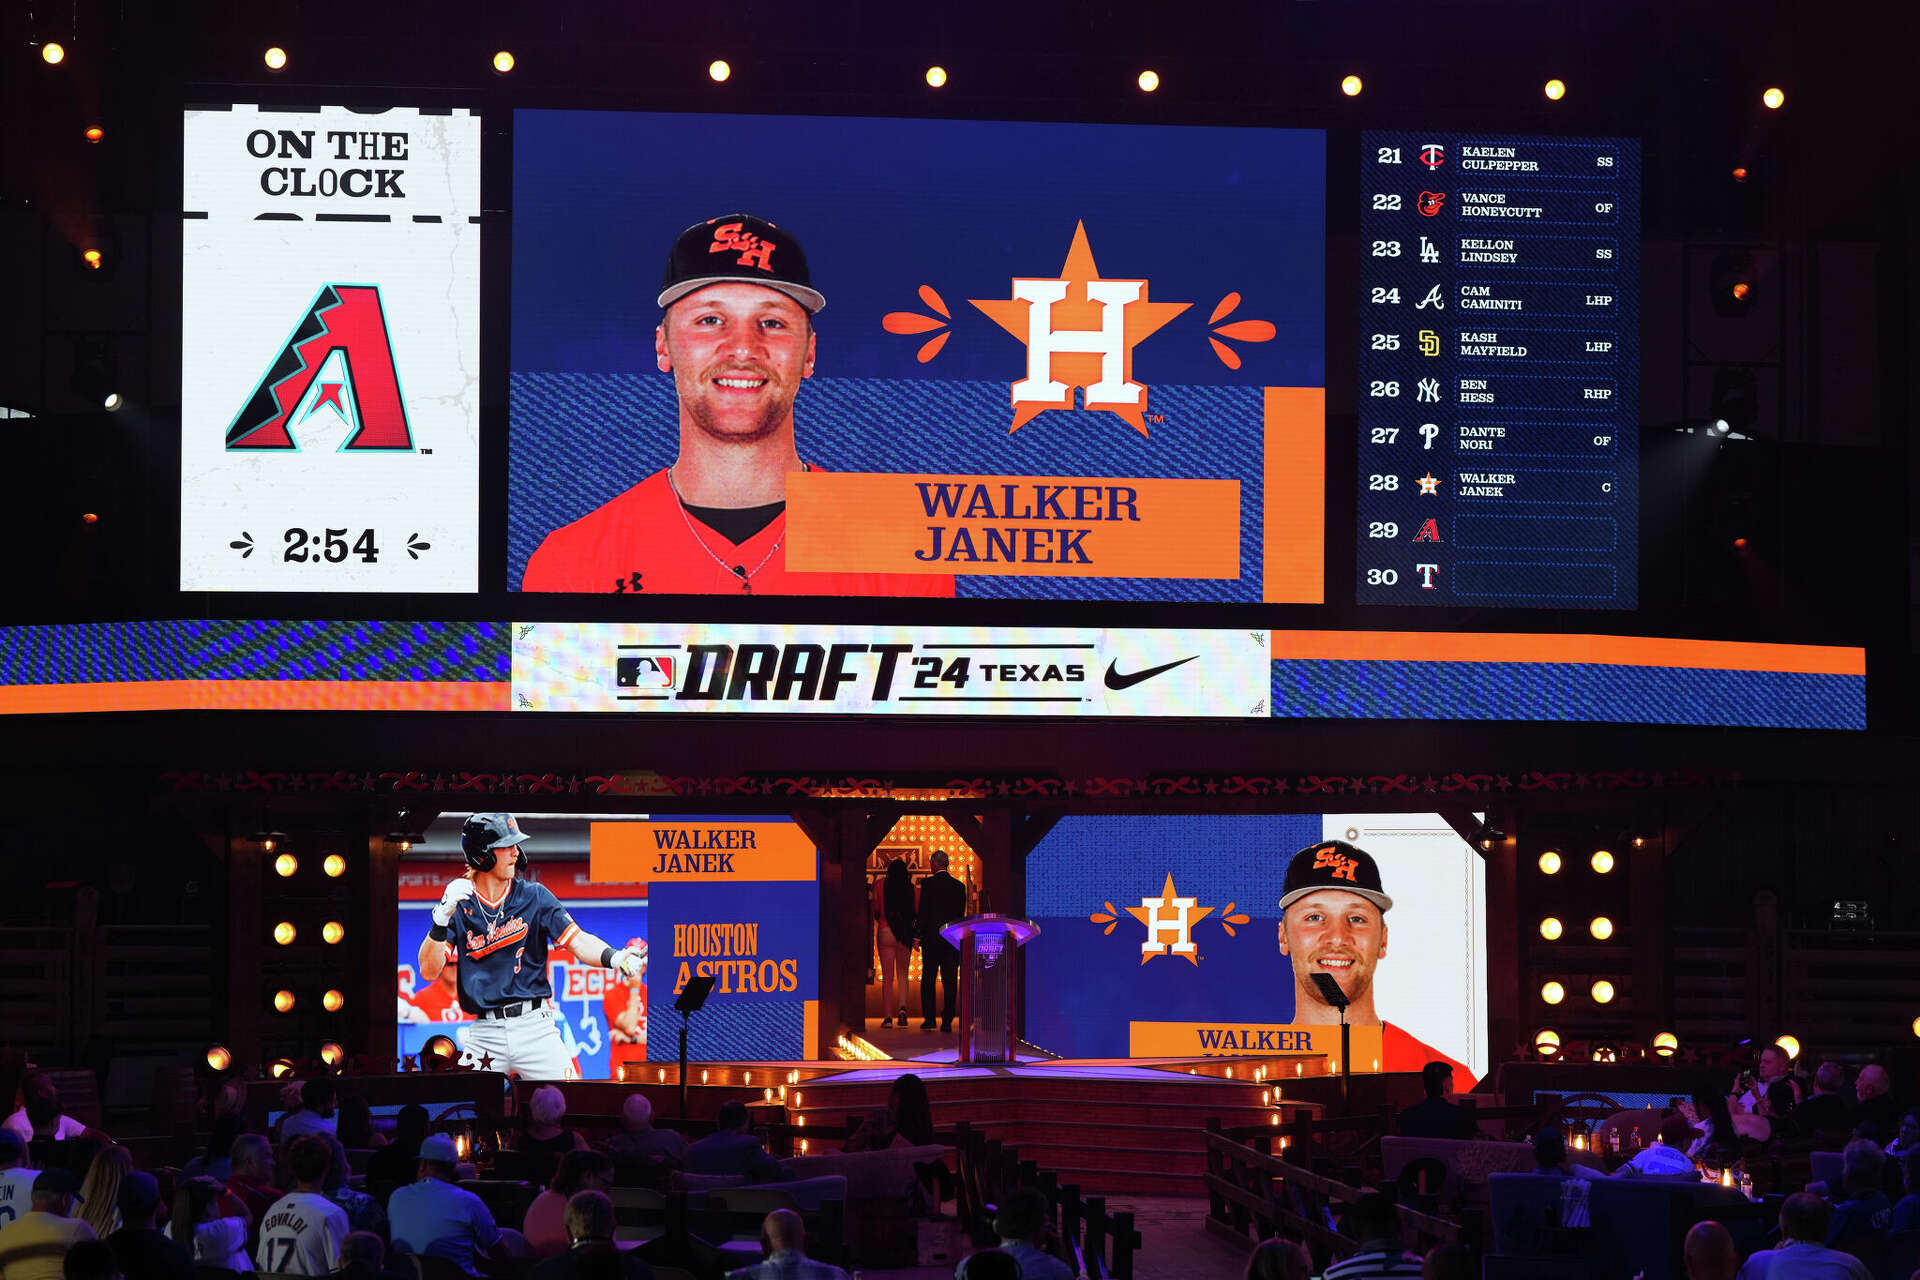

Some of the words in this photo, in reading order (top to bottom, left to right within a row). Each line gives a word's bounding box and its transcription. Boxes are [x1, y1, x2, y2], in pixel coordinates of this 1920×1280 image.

[246, 129, 316, 159] ON
[328, 131, 409, 161] THE
[1377, 147, 1402, 164] 21
[1462, 147, 1516, 158] KAELEN
[1462, 160, 1540, 172] CULPEPPER
[1597, 157, 1614, 168] SS
[260, 167, 406, 198] CLOCK
[1373, 194, 1402, 211] 22
[1462, 193, 1506, 204] VANCE
[1462, 206, 1543, 218] HONEYCUTT
[1595, 203, 1613, 213] OF
[1372, 240, 1402, 257] 23
[1461, 239, 1514, 250] KELLON
[1461, 252, 1518, 263] LINDSEY
[1596, 249, 1613, 259] SS
[1371, 287, 1401, 304] 24
[1461, 286, 1491, 296] CAM
[1461, 299, 1523, 311] CAMINITI
[1586, 295, 1612, 306] LHP
[1371, 334, 1400, 351] 25
[1461, 332, 1498, 343] KASH
[1461, 346, 1528, 357] MAYFIELD
[1586, 342, 1612, 352] LHP
[1370, 381, 1400, 397] 26
[1460, 380, 1487, 390] BEN
[1460, 393, 1495, 403] HESS
[1584, 389, 1612, 400] RHP
[1371, 428, 1400, 444] 27
[1460, 427, 1506, 438] DANTE
[1460, 440, 1494, 450] NORI
[1593, 436, 1612, 446] OF
[1369, 474, 1399, 491] 28
[1460, 473, 1516, 484] WALKER
[1460, 486, 1504, 497] JANEK
[1601, 482, 1612, 493] C
[914, 482, 1141, 522] WALKER
[1369, 521, 1399, 538] 29
[283, 527, 379, 564] 2:54
[914, 526, 1094, 564] JANEK
[1367, 568, 1399, 586] 30
[675, 644, 914, 702] DRAFT
[911, 657, 971, 689] '24
[979, 664, 1085, 682] TEXAS
[652, 829, 757, 850] WALKER
[652, 853, 735, 873] JANEK
[673, 923, 758, 957] HOUSTON
[672, 959, 798, 995] ASTROS
[1197, 1029, 1313, 1051] WALKER
[264, 1212, 308, 1235] EOVALDI
[266, 1237, 297, 1273] 17
